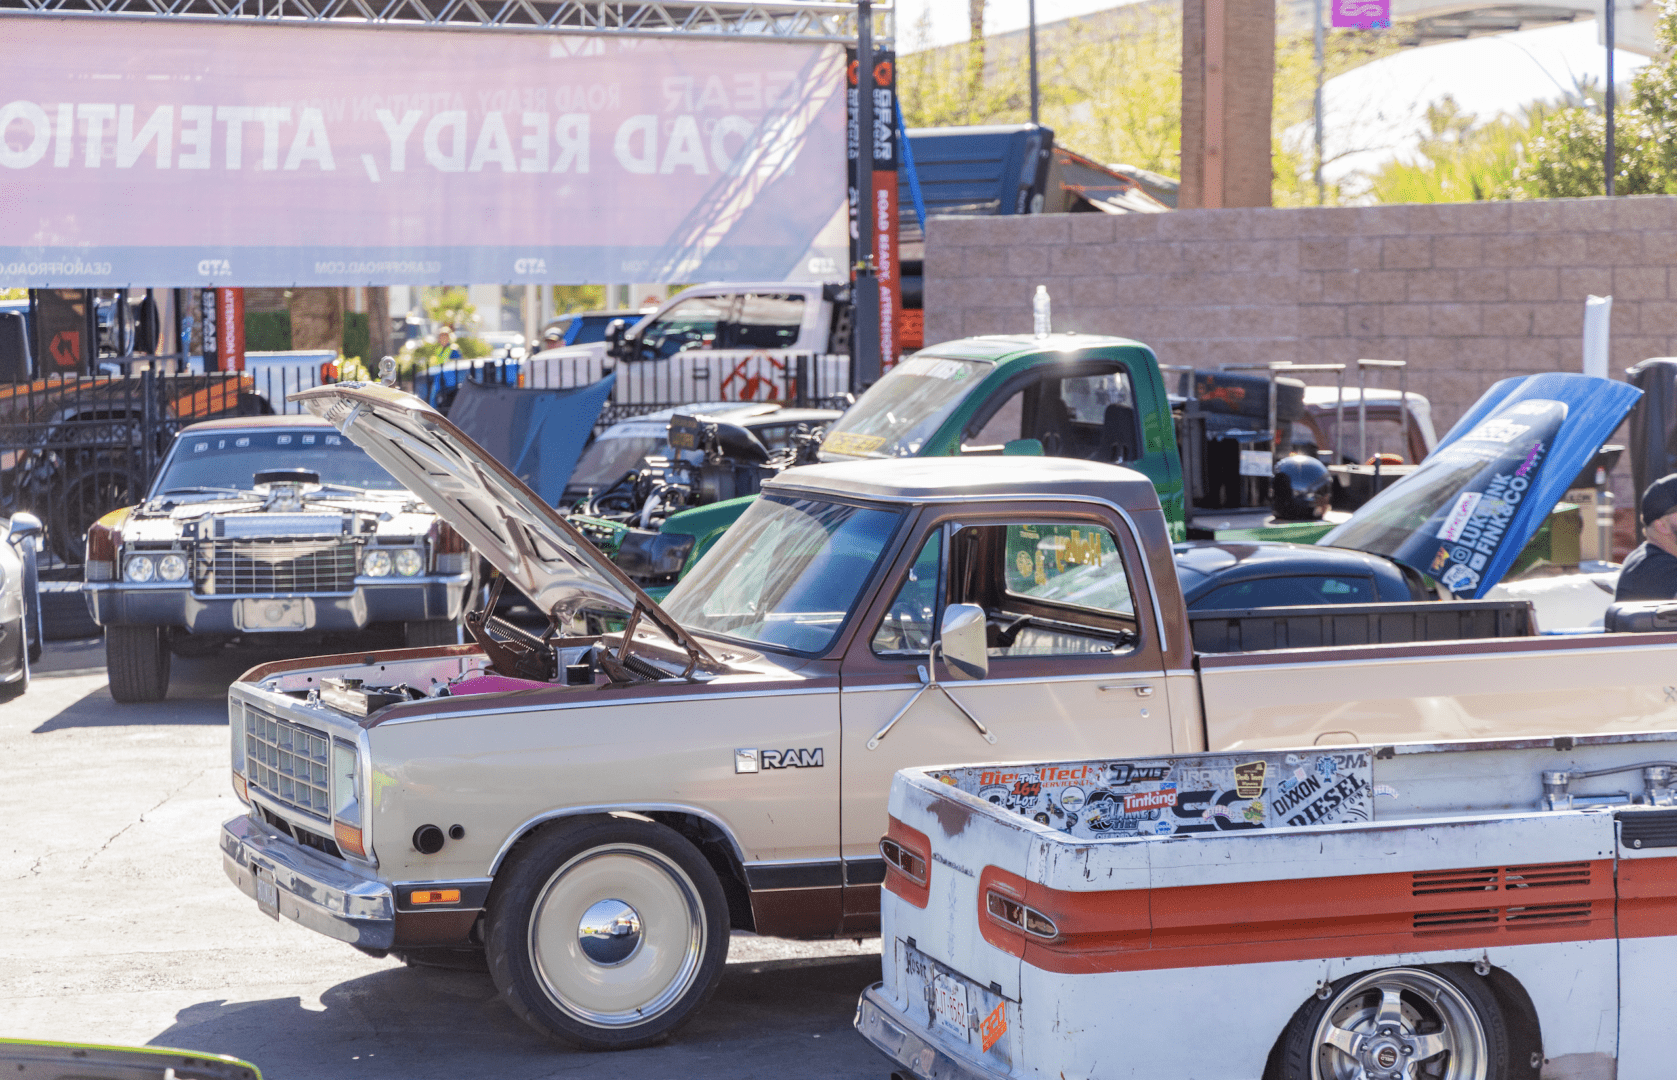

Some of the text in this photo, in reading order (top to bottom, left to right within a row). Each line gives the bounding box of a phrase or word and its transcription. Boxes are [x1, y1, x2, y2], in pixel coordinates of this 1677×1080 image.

[761, 748, 824, 770] RAM
[1011, 781, 1042, 796] 164
[1272, 775, 1321, 816] DIXXON
[1124, 792, 1176, 809] Tintking
[1286, 773, 1367, 827] DIESEL
